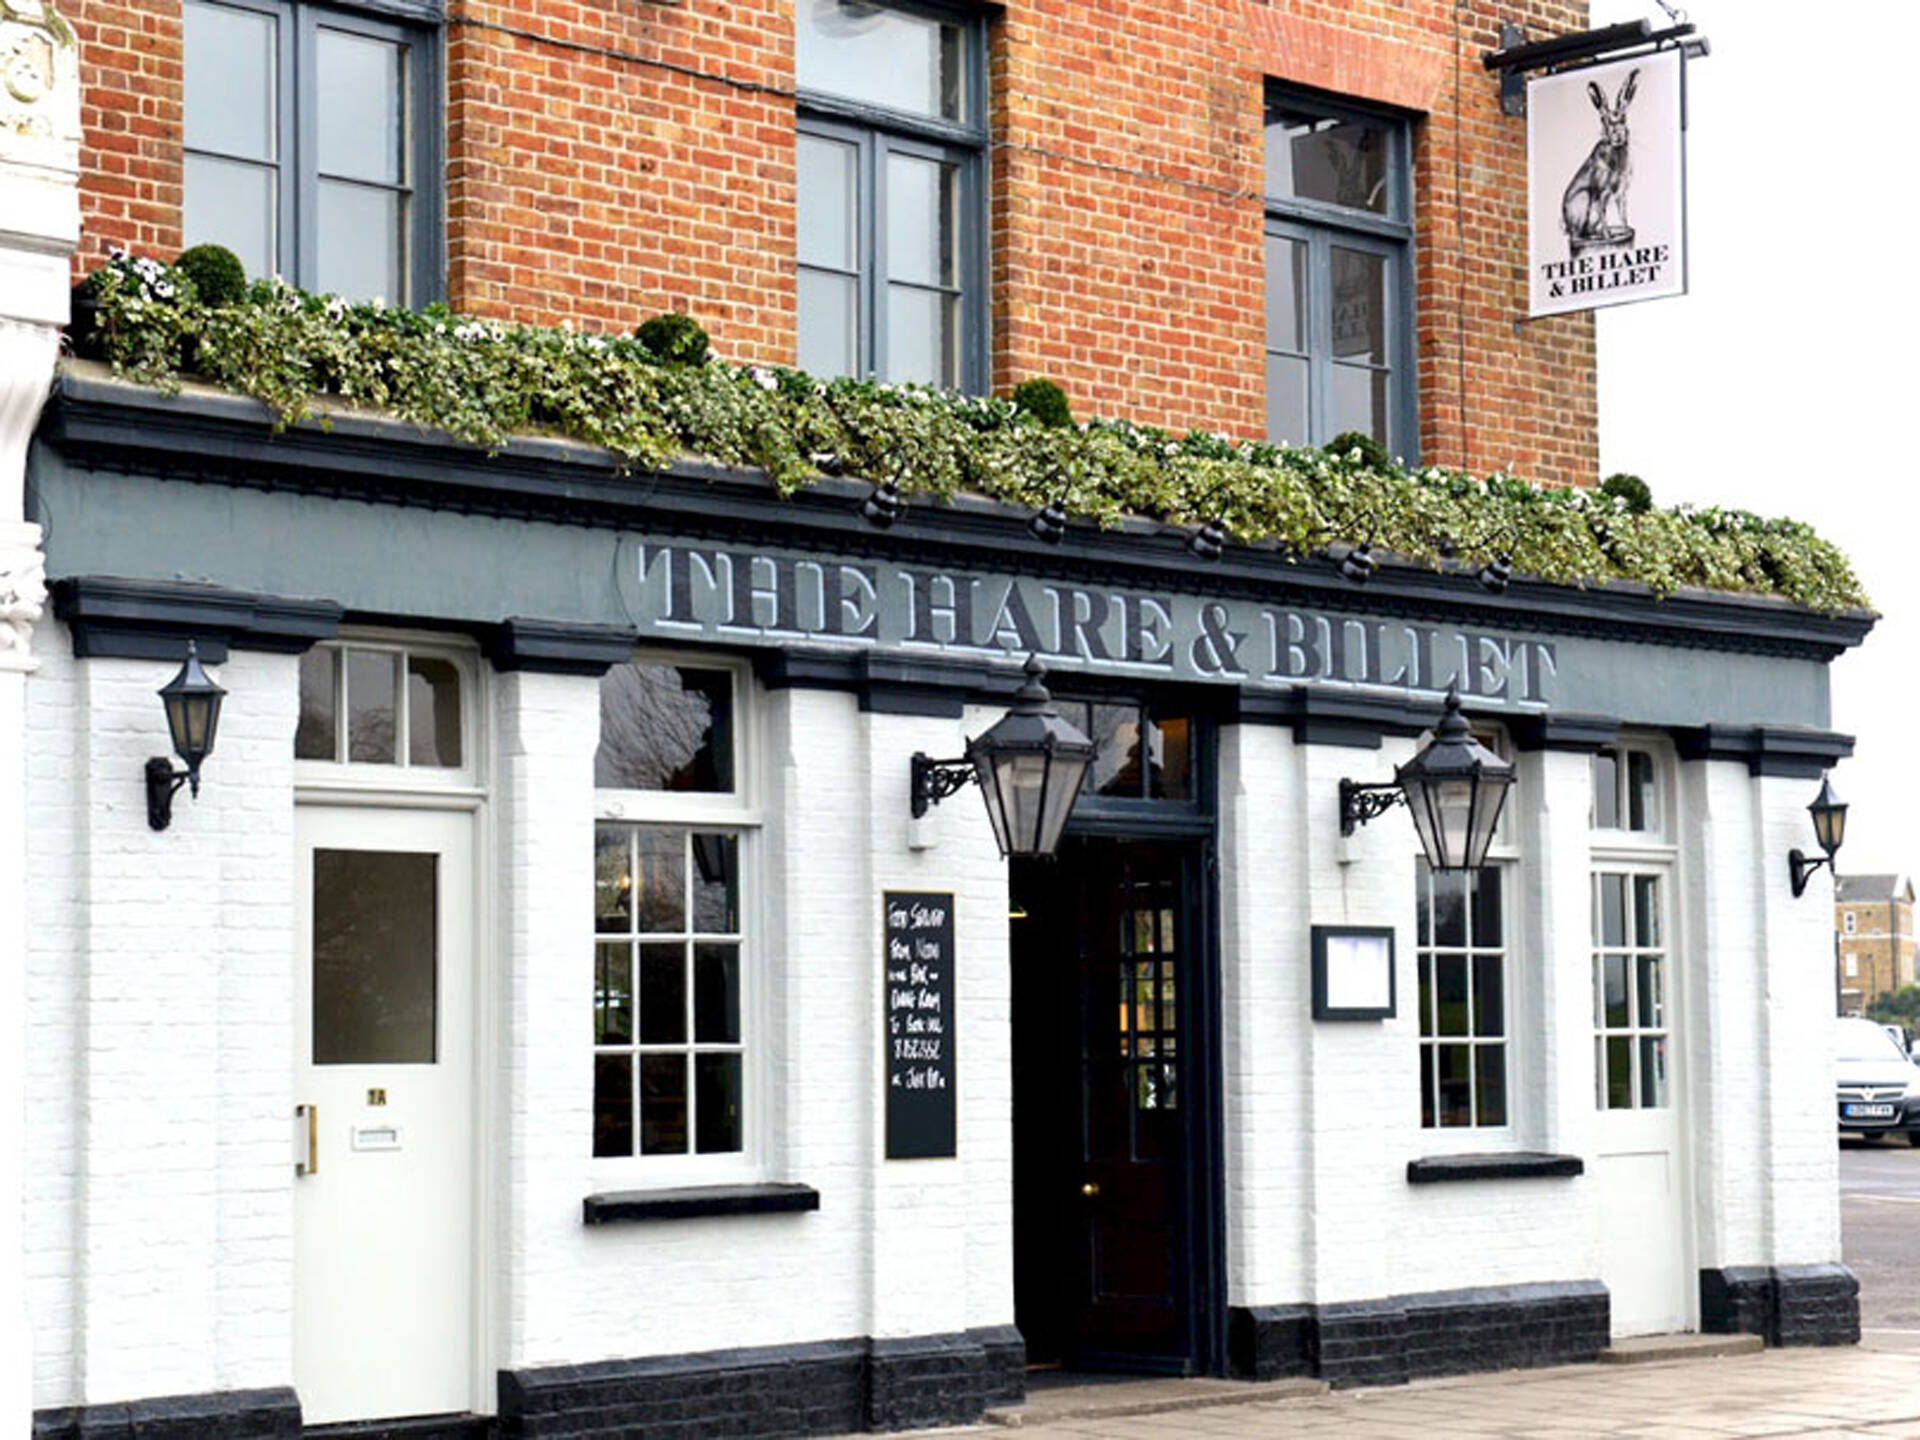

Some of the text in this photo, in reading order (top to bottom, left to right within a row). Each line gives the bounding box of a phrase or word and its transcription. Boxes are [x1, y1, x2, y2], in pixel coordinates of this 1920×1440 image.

[1542, 244, 1669, 280] THE HARE
[1549, 265, 1661, 298] & BILLET
[639, 544, 1557, 709] THE HARE & BILLET
